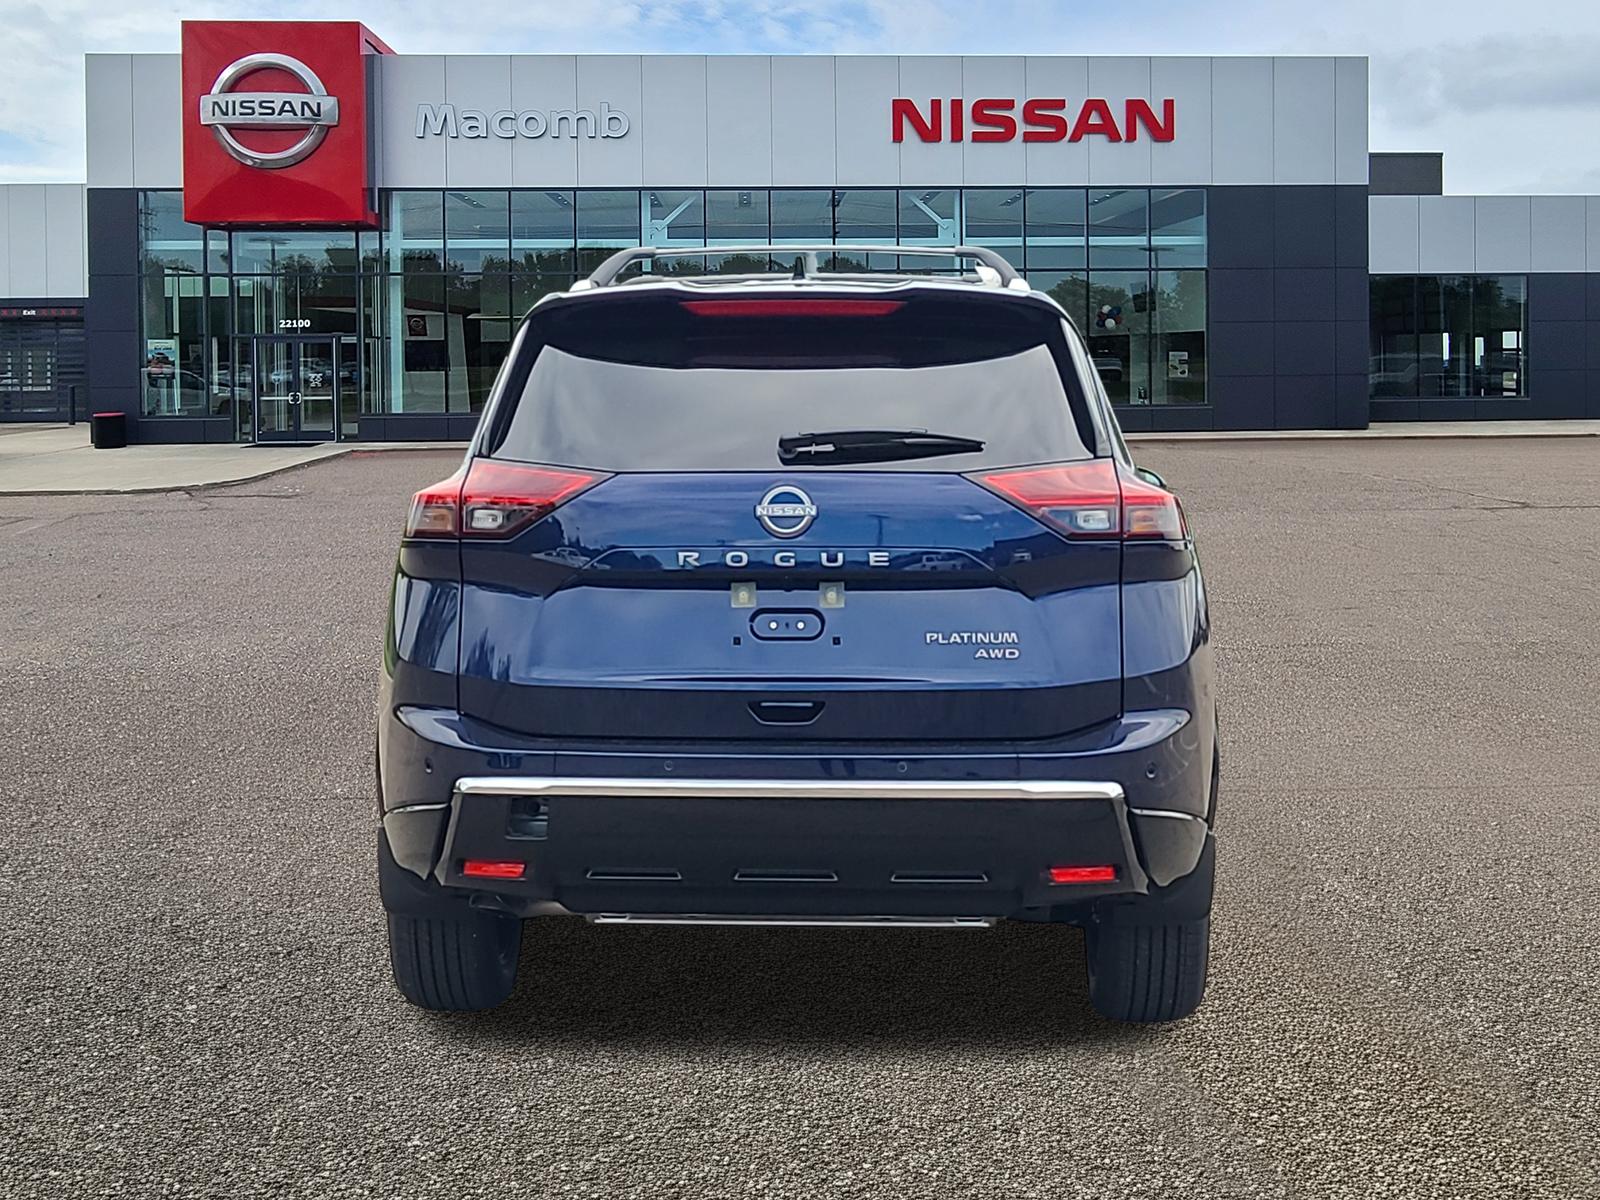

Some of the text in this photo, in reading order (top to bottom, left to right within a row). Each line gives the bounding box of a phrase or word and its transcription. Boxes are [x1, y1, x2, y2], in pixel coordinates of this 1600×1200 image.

[211, 100, 322, 118] NISSAN
[415, 101, 630, 139] Macomb
[891, 98, 1175, 143] NISSAN
[279, 319, 311, 328] 22100
[757, 506, 816, 516] NISSAN
[677, 551, 891, 568] ROGUE
[925, 631, 1019, 644] PLATINUM
[974, 648, 1020, 659] AWD
